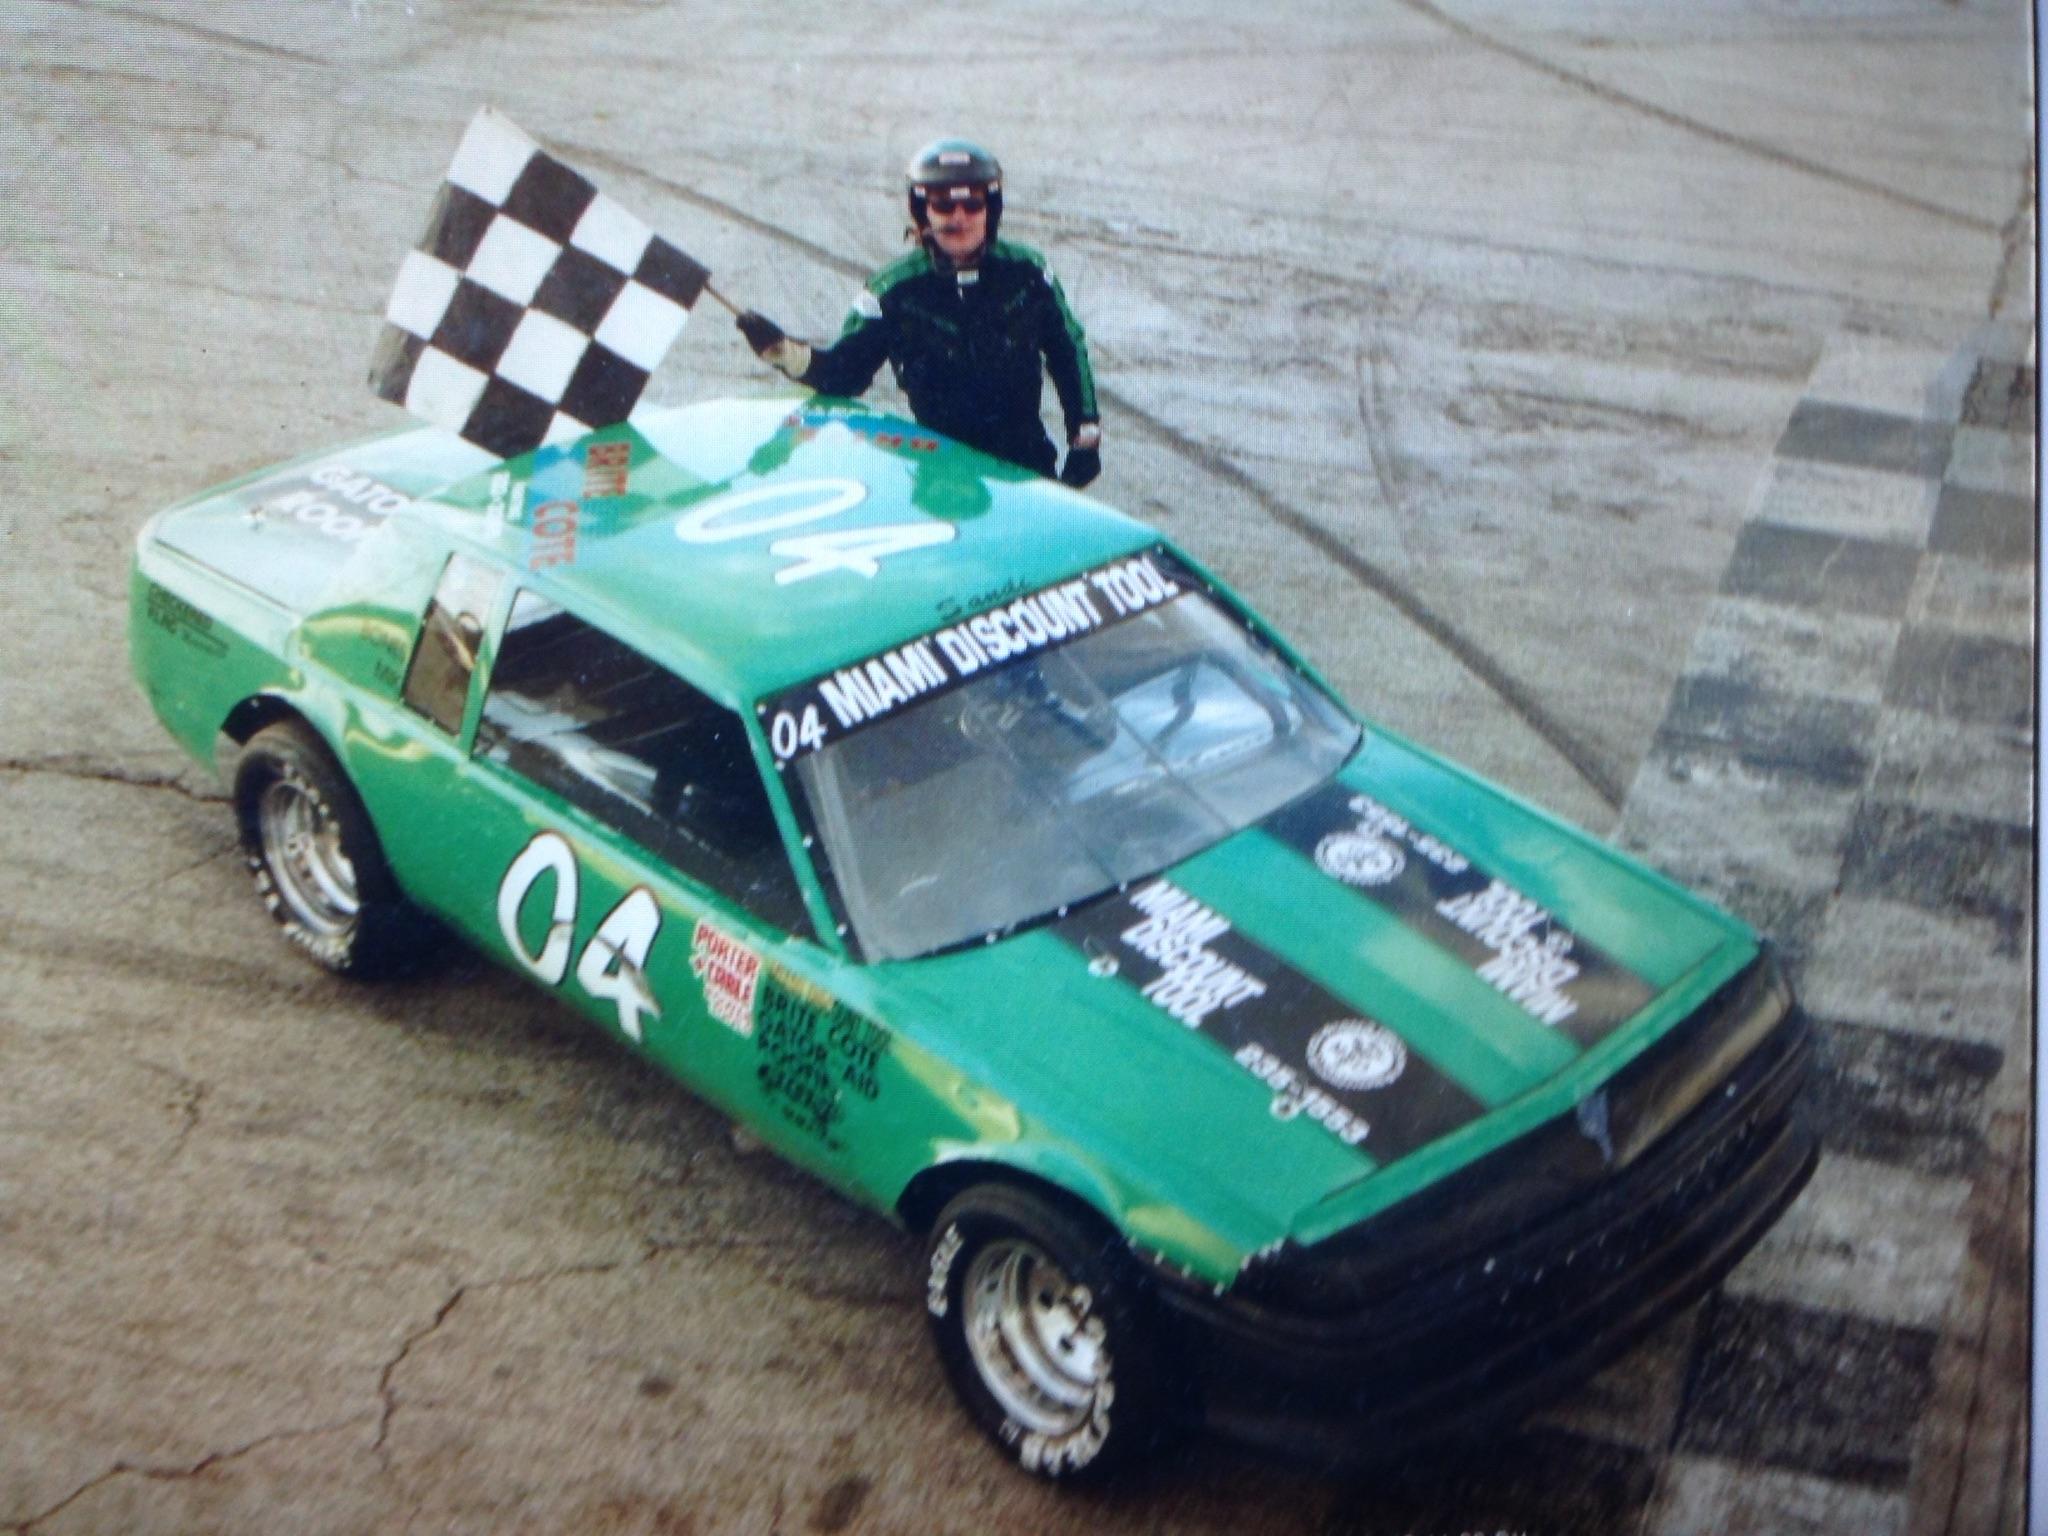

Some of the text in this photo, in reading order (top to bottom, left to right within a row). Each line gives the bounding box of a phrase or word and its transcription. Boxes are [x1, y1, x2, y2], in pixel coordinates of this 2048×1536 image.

[675, 477, 958, 588] 04
[771, 556, 1179, 758] 04 MIAMI DISCOUNT TOOL
[497, 829, 663, 1044] 04
[696, 924, 758, 979] PORTER
[1130, 877, 1233, 952] MIAMI
[1119, 915, 1268, 1010] DISCOUNT
[1139, 964, 1222, 1029] TOOL
[828, 1026, 880, 1071] COTE
